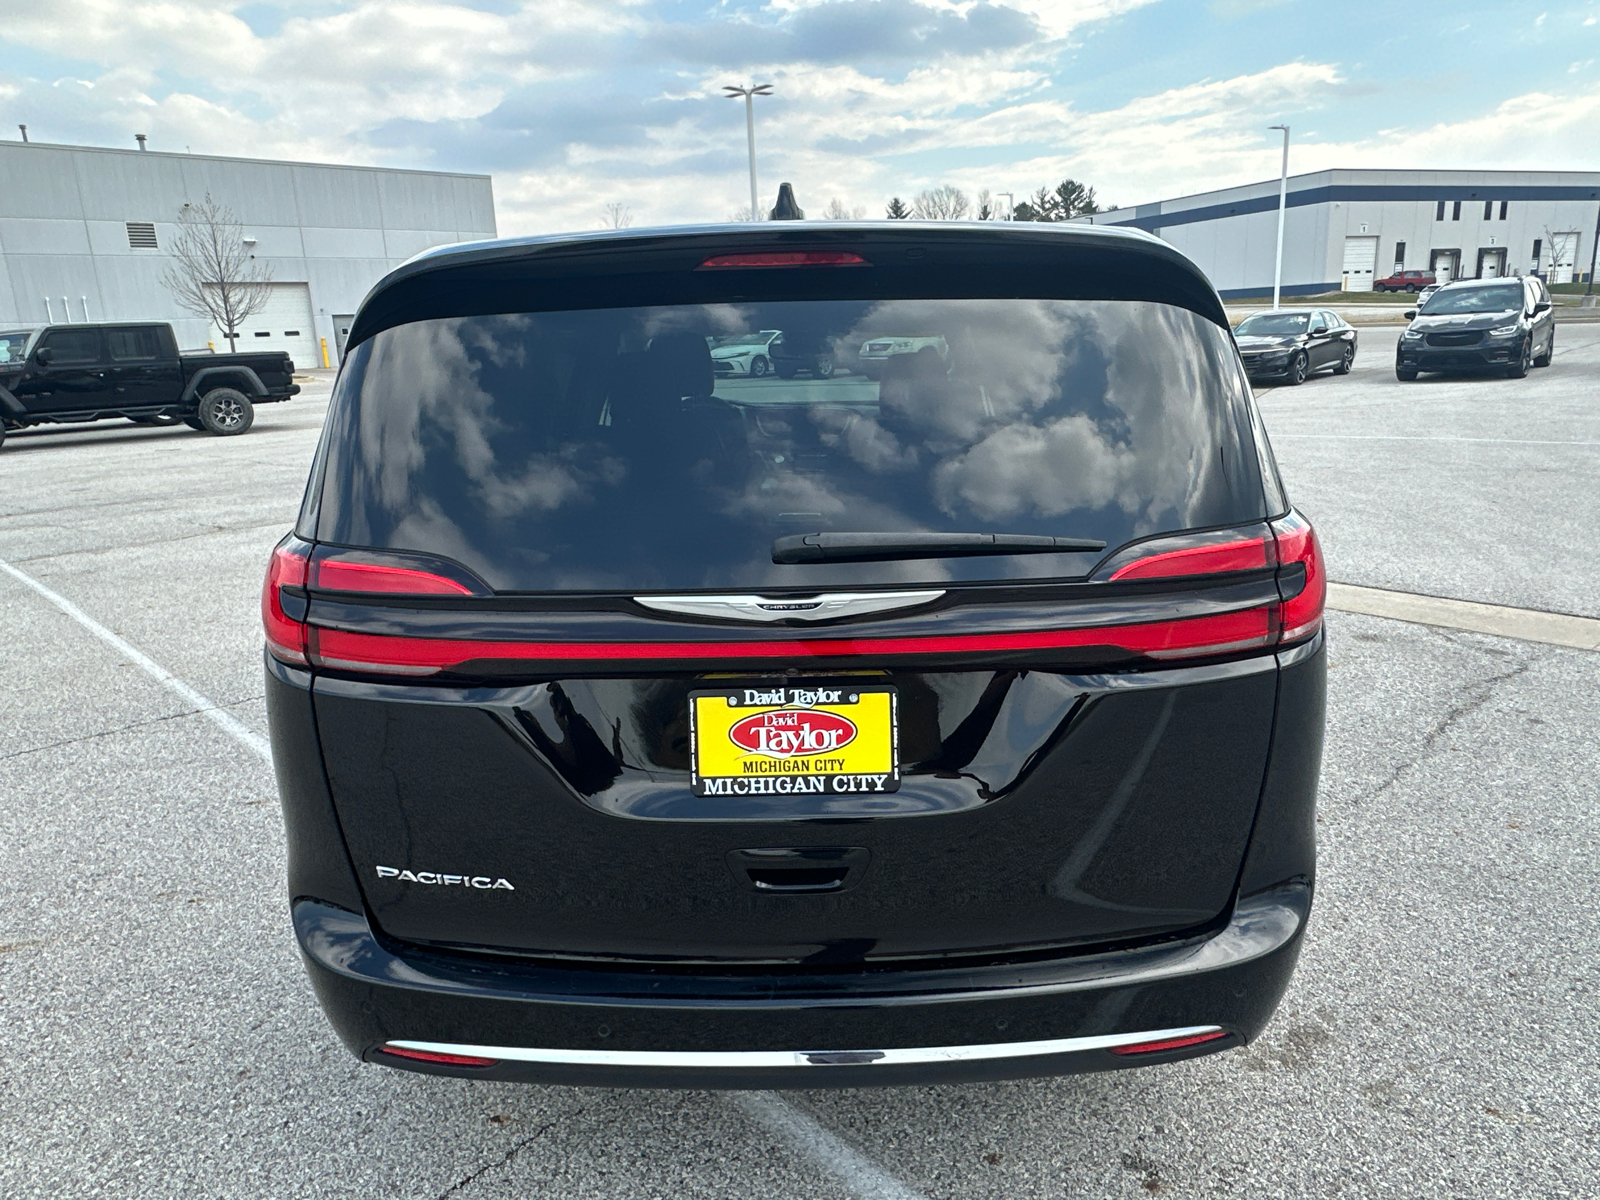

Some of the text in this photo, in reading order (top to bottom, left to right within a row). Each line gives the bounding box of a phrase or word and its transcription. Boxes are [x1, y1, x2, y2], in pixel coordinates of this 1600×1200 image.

[743, 687, 842, 708] David Taylor
[763, 714, 798, 727] David
[749, 723, 843, 758] Taylor
[742, 759, 846, 774] MICHIGAN CITY
[703, 774, 888, 795] MICHIGAN CITY
[375, 865, 515, 890] PACIFICA
